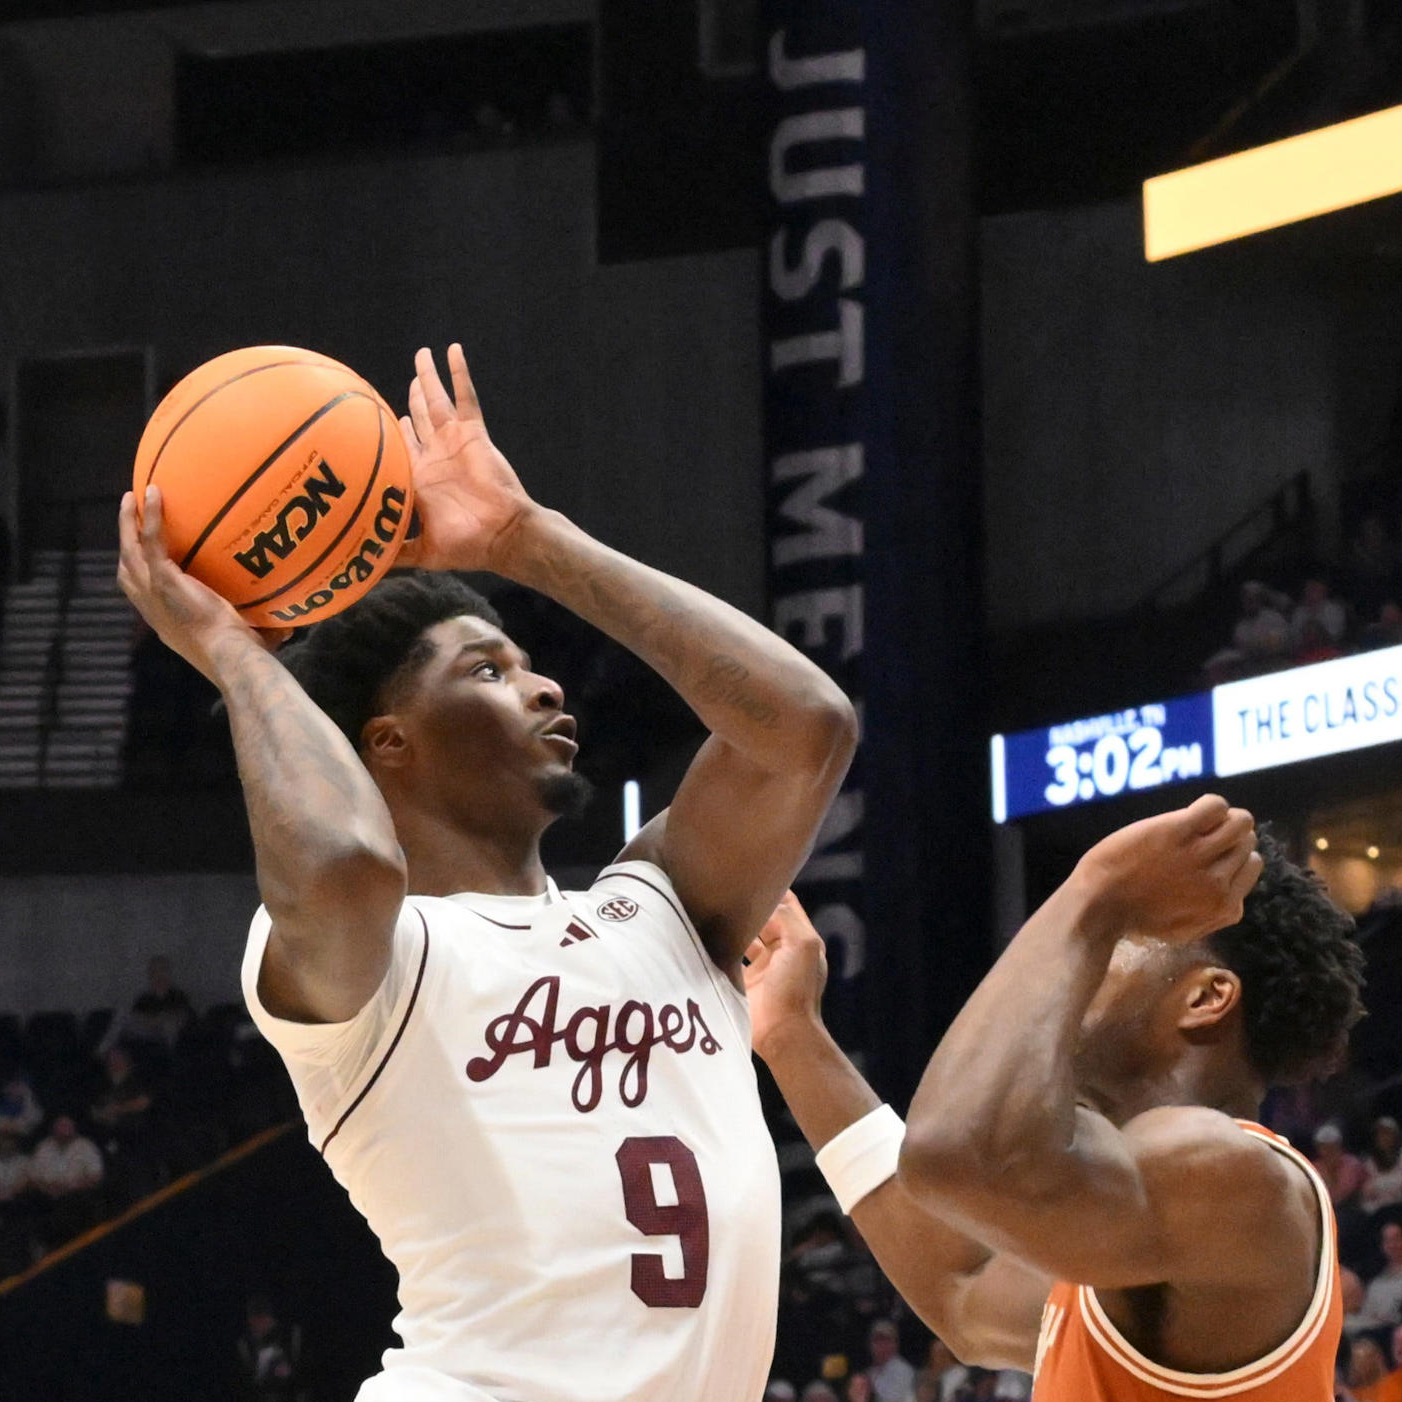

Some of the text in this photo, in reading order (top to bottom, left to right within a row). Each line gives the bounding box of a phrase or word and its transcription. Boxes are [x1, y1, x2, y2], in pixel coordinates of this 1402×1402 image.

[769, 30, 866, 389] JUST
[234, 459, 346, 579] NCAA
[270, 485, 406, 621] Wilson
[1237, 699, 1292, 748] THE
[600, 899, 635, 920] SEC
[615, 1136, 710, 1308] 9
